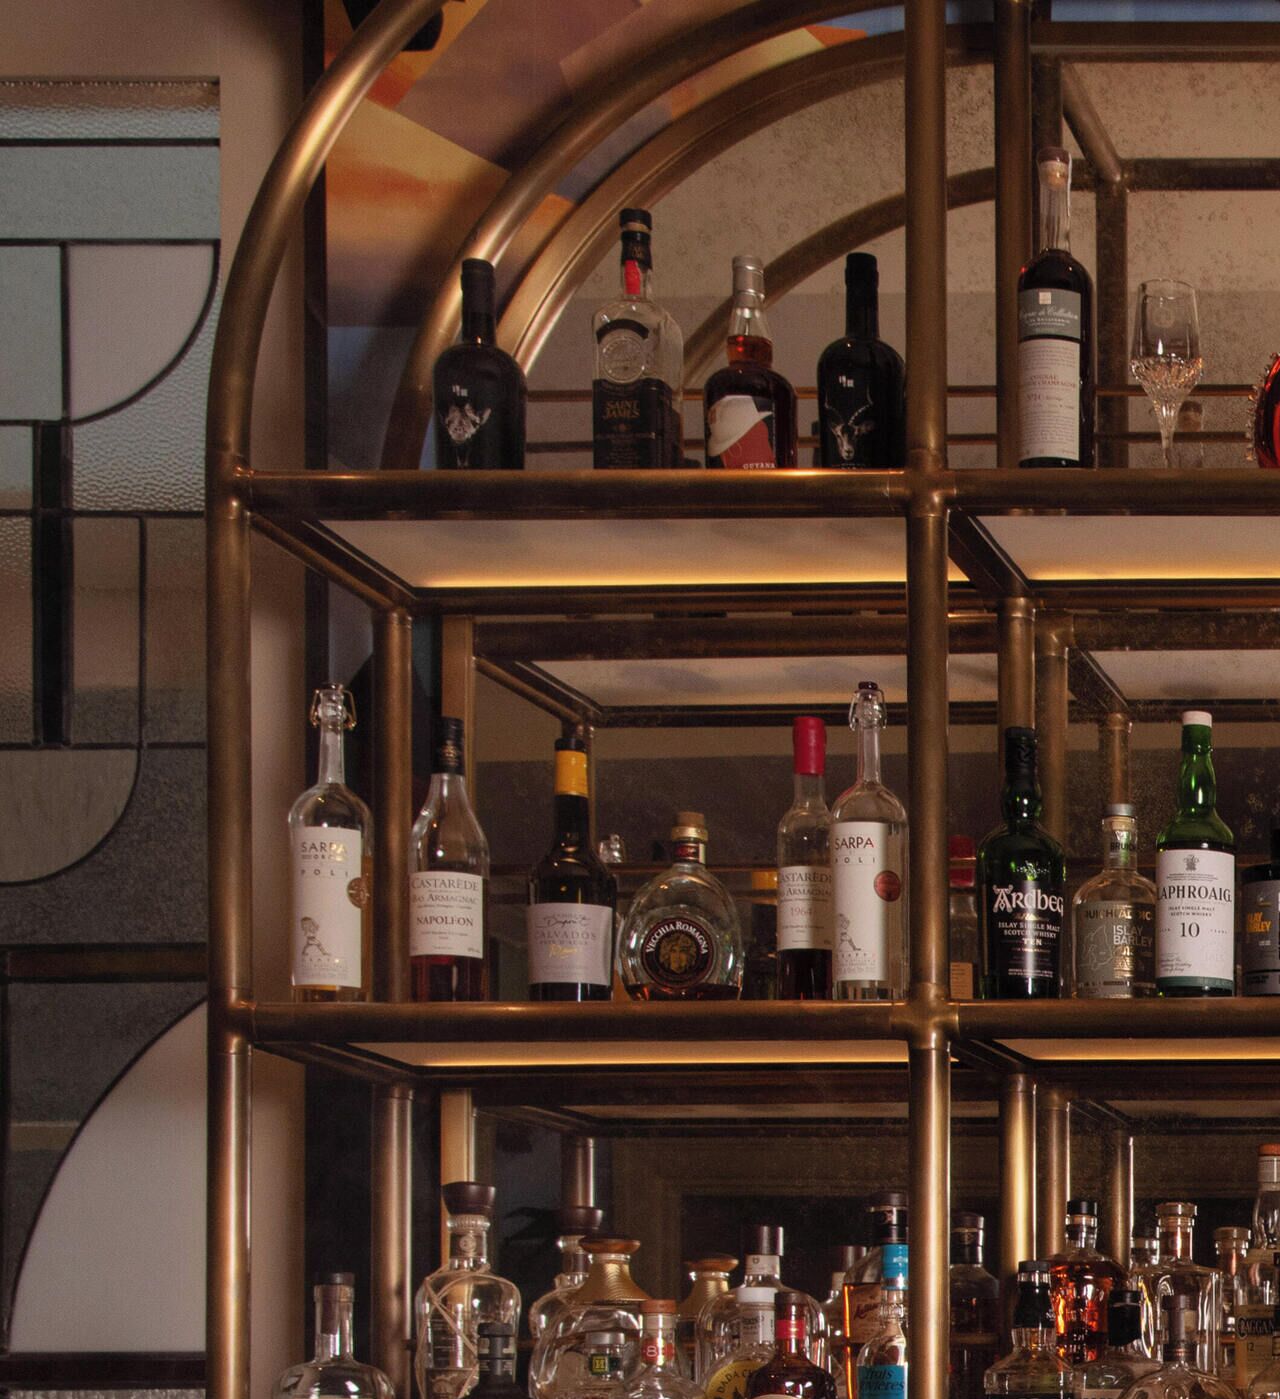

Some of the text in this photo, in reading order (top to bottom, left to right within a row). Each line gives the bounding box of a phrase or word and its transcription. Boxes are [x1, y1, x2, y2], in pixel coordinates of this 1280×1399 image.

[835, 837, 874, 850] SARPA
[998, 921, 1061, 933] ISLAY SINGLE MALT
[1113, 925, 1143, 936] ISLAY
[1180, 922, 1200, 938] 10
[645, 921, 709, 954] VECCHIA ROMAGNA
[1004, 929, 1057, 940] SCOTCH WHISKY
[1023, 938, 1042, 946] TEN
[1113, 935, 1153, 946] BARLEY
